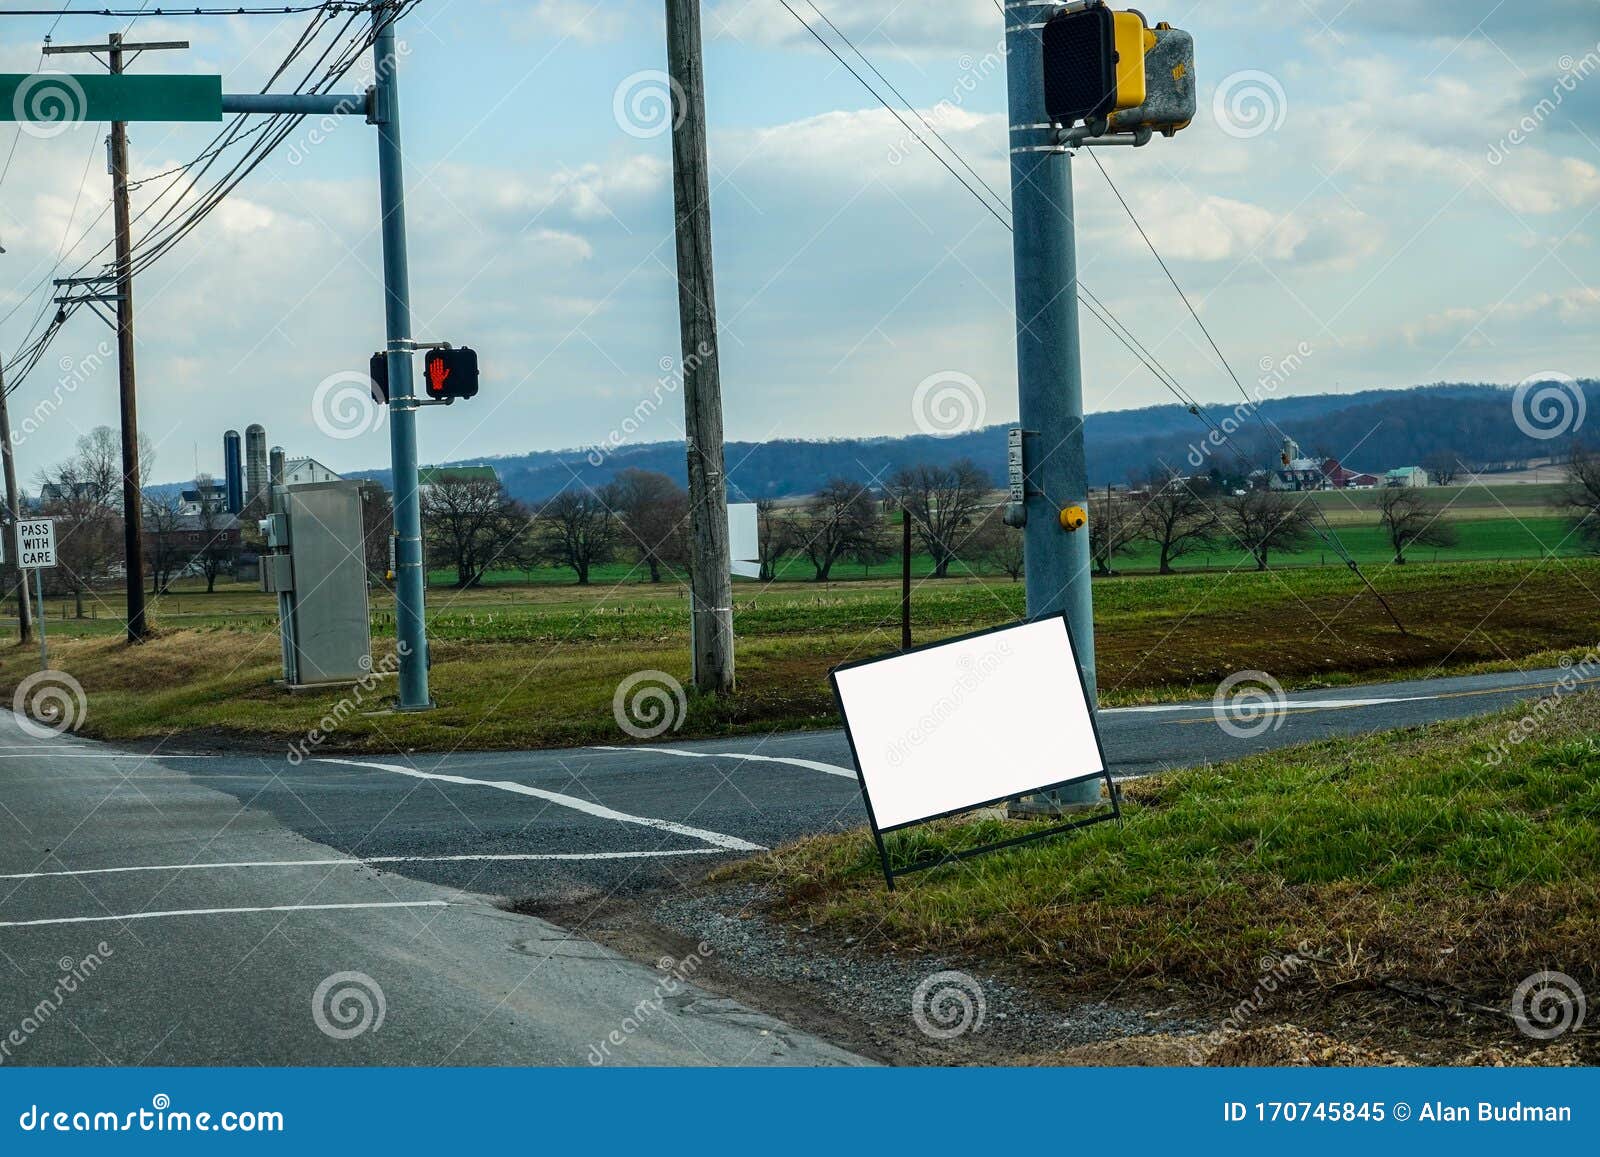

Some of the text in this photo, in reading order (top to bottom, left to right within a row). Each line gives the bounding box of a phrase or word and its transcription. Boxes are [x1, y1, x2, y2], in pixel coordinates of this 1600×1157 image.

[21, 524, 49, 536] PASS
[23, 538, 49, 550] WITH
[22, 551, 51, 564] CARE
